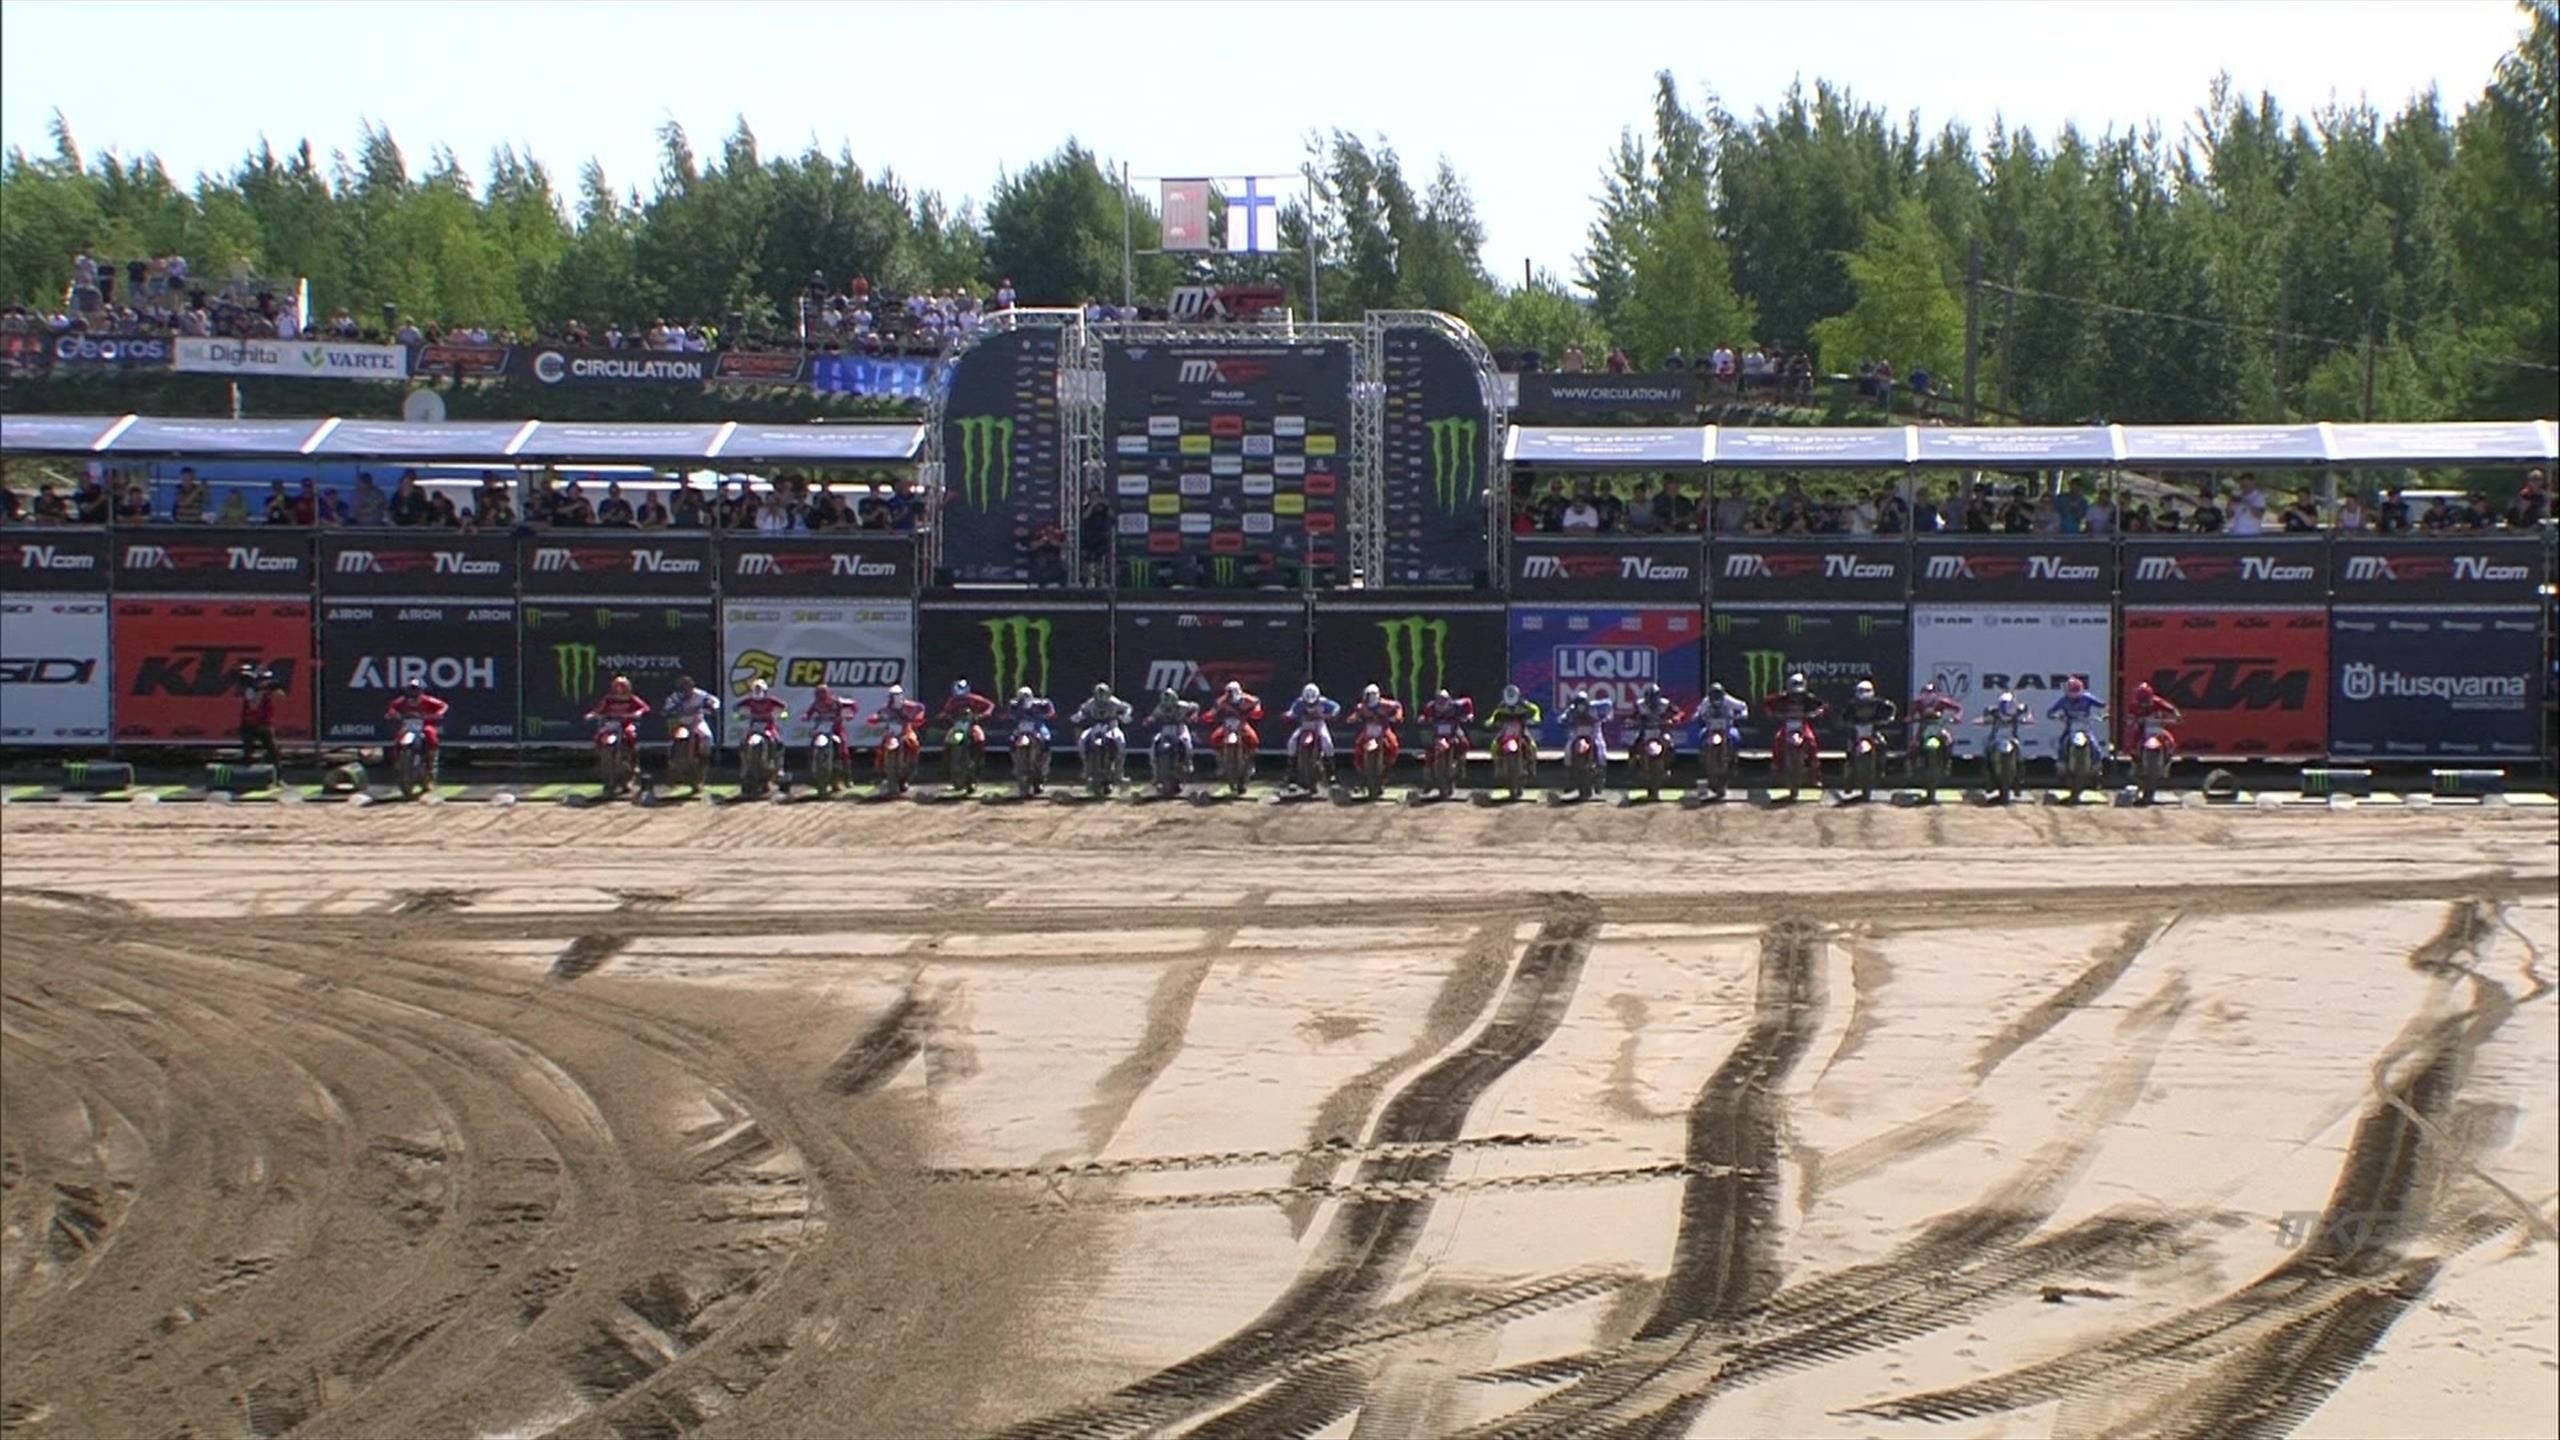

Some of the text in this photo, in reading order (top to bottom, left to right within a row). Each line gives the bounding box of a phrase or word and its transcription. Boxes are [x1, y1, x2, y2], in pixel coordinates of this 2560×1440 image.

[210, 344, 278, 366] Dignita
[328, 351, 395, 369] VARTE
[571, 357, 701, 379] CIRCULATION
[349, 656, 494, 688] AIROH
[597, 654, 683, 670] MONSTER
[789, 658, 900, 684] FC MOTO
[1559, 650, 1651, 679] LIQUI
[1786, 661, 1873, 676] MONSTER
[2152, 656, 2311, 710] KTM
[2379, 671, 2526, 698] Husqvarna
